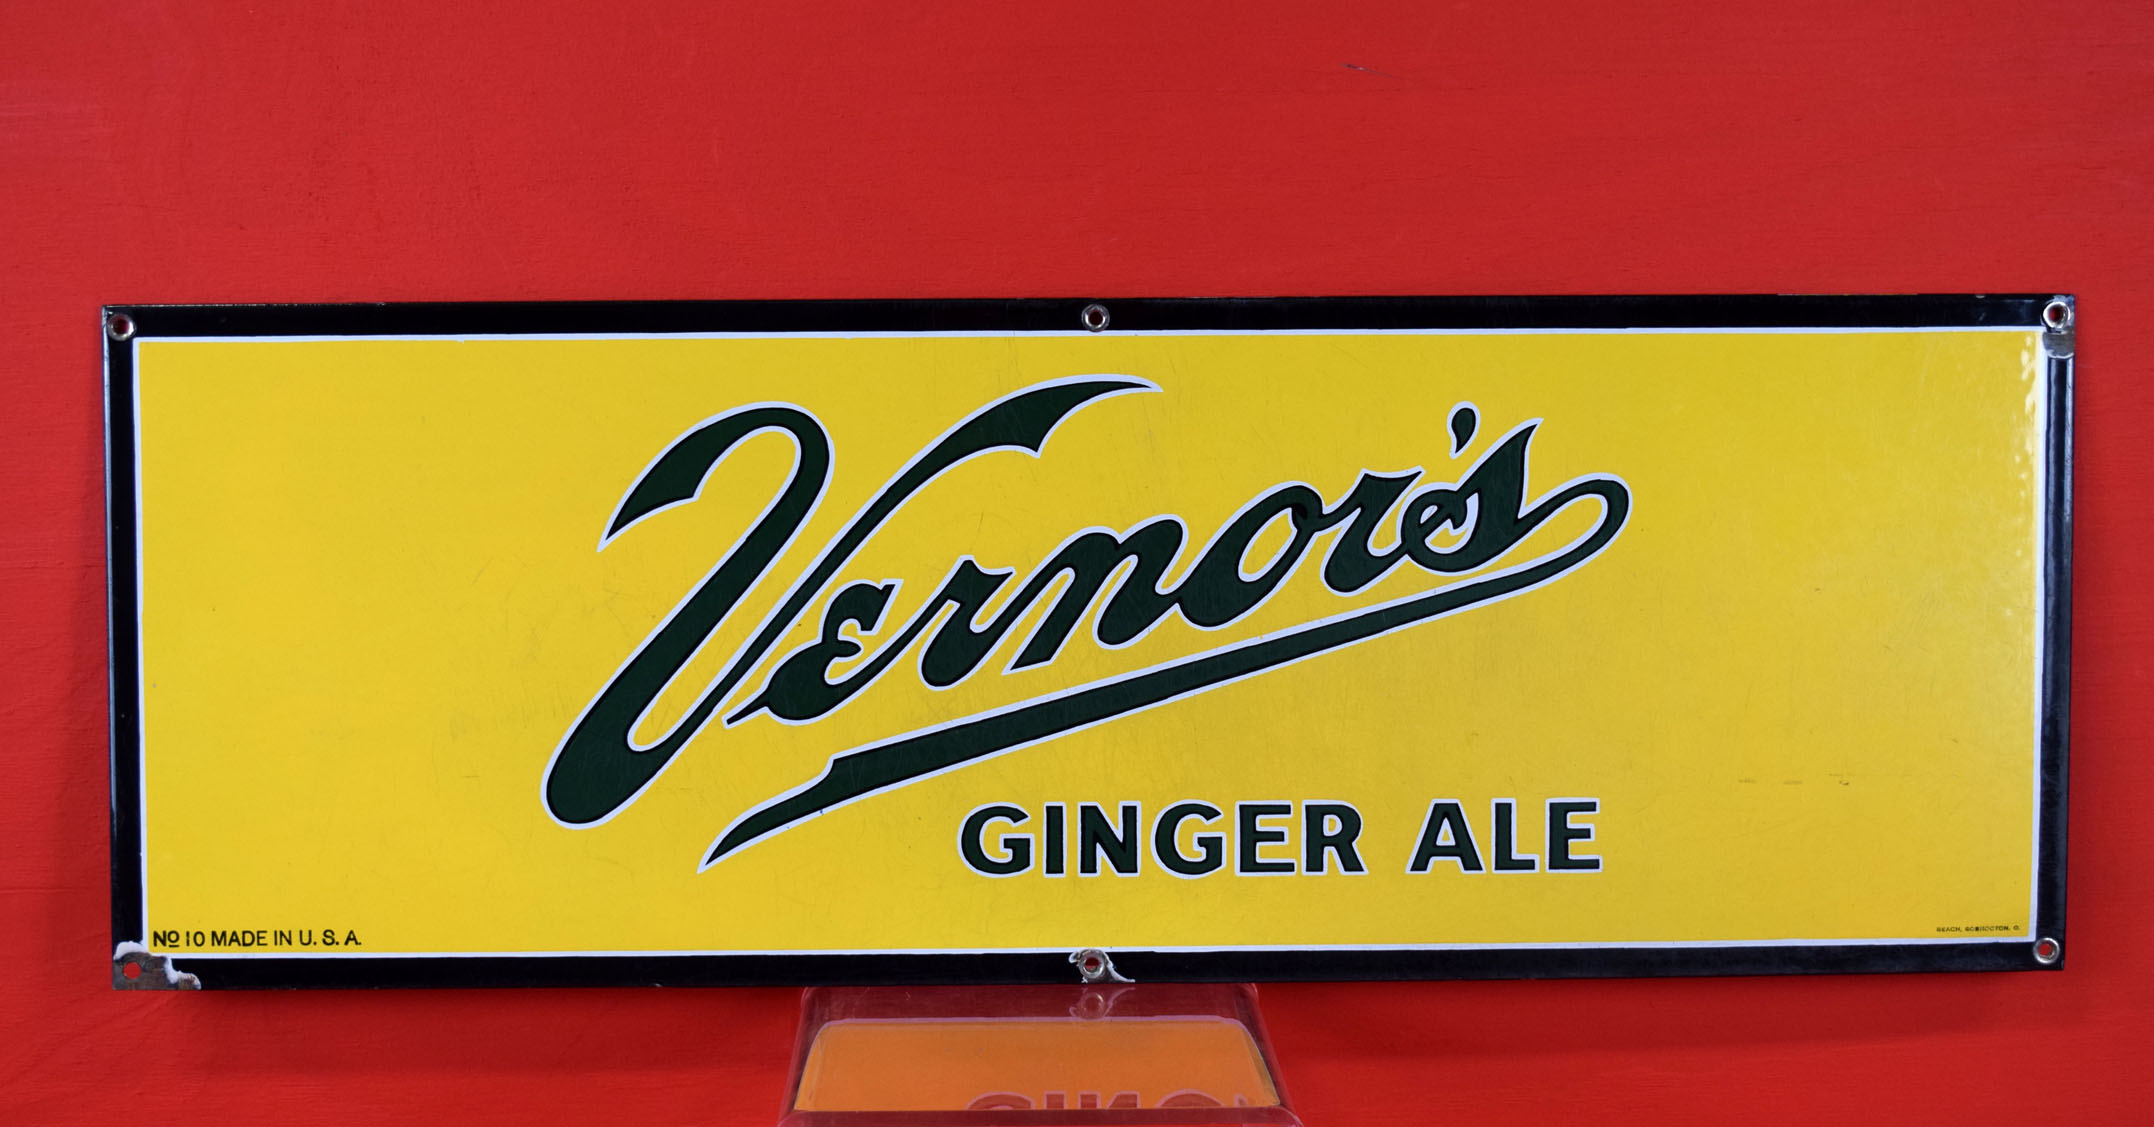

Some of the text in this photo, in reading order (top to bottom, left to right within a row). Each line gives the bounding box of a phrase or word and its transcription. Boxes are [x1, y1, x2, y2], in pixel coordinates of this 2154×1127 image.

[544, 375, 1631, 873] Vernor's
[957, 796, 1603, 878] GINGER ALE
[185, 930, 206, 948] 10
[210, 930, 269, 948] MADE
[273, 929, 293, 947] IN
[299, 929, 318, 947] U.
[321, 928, 340, 947] S.
[343, 929, 362, 947] A.
